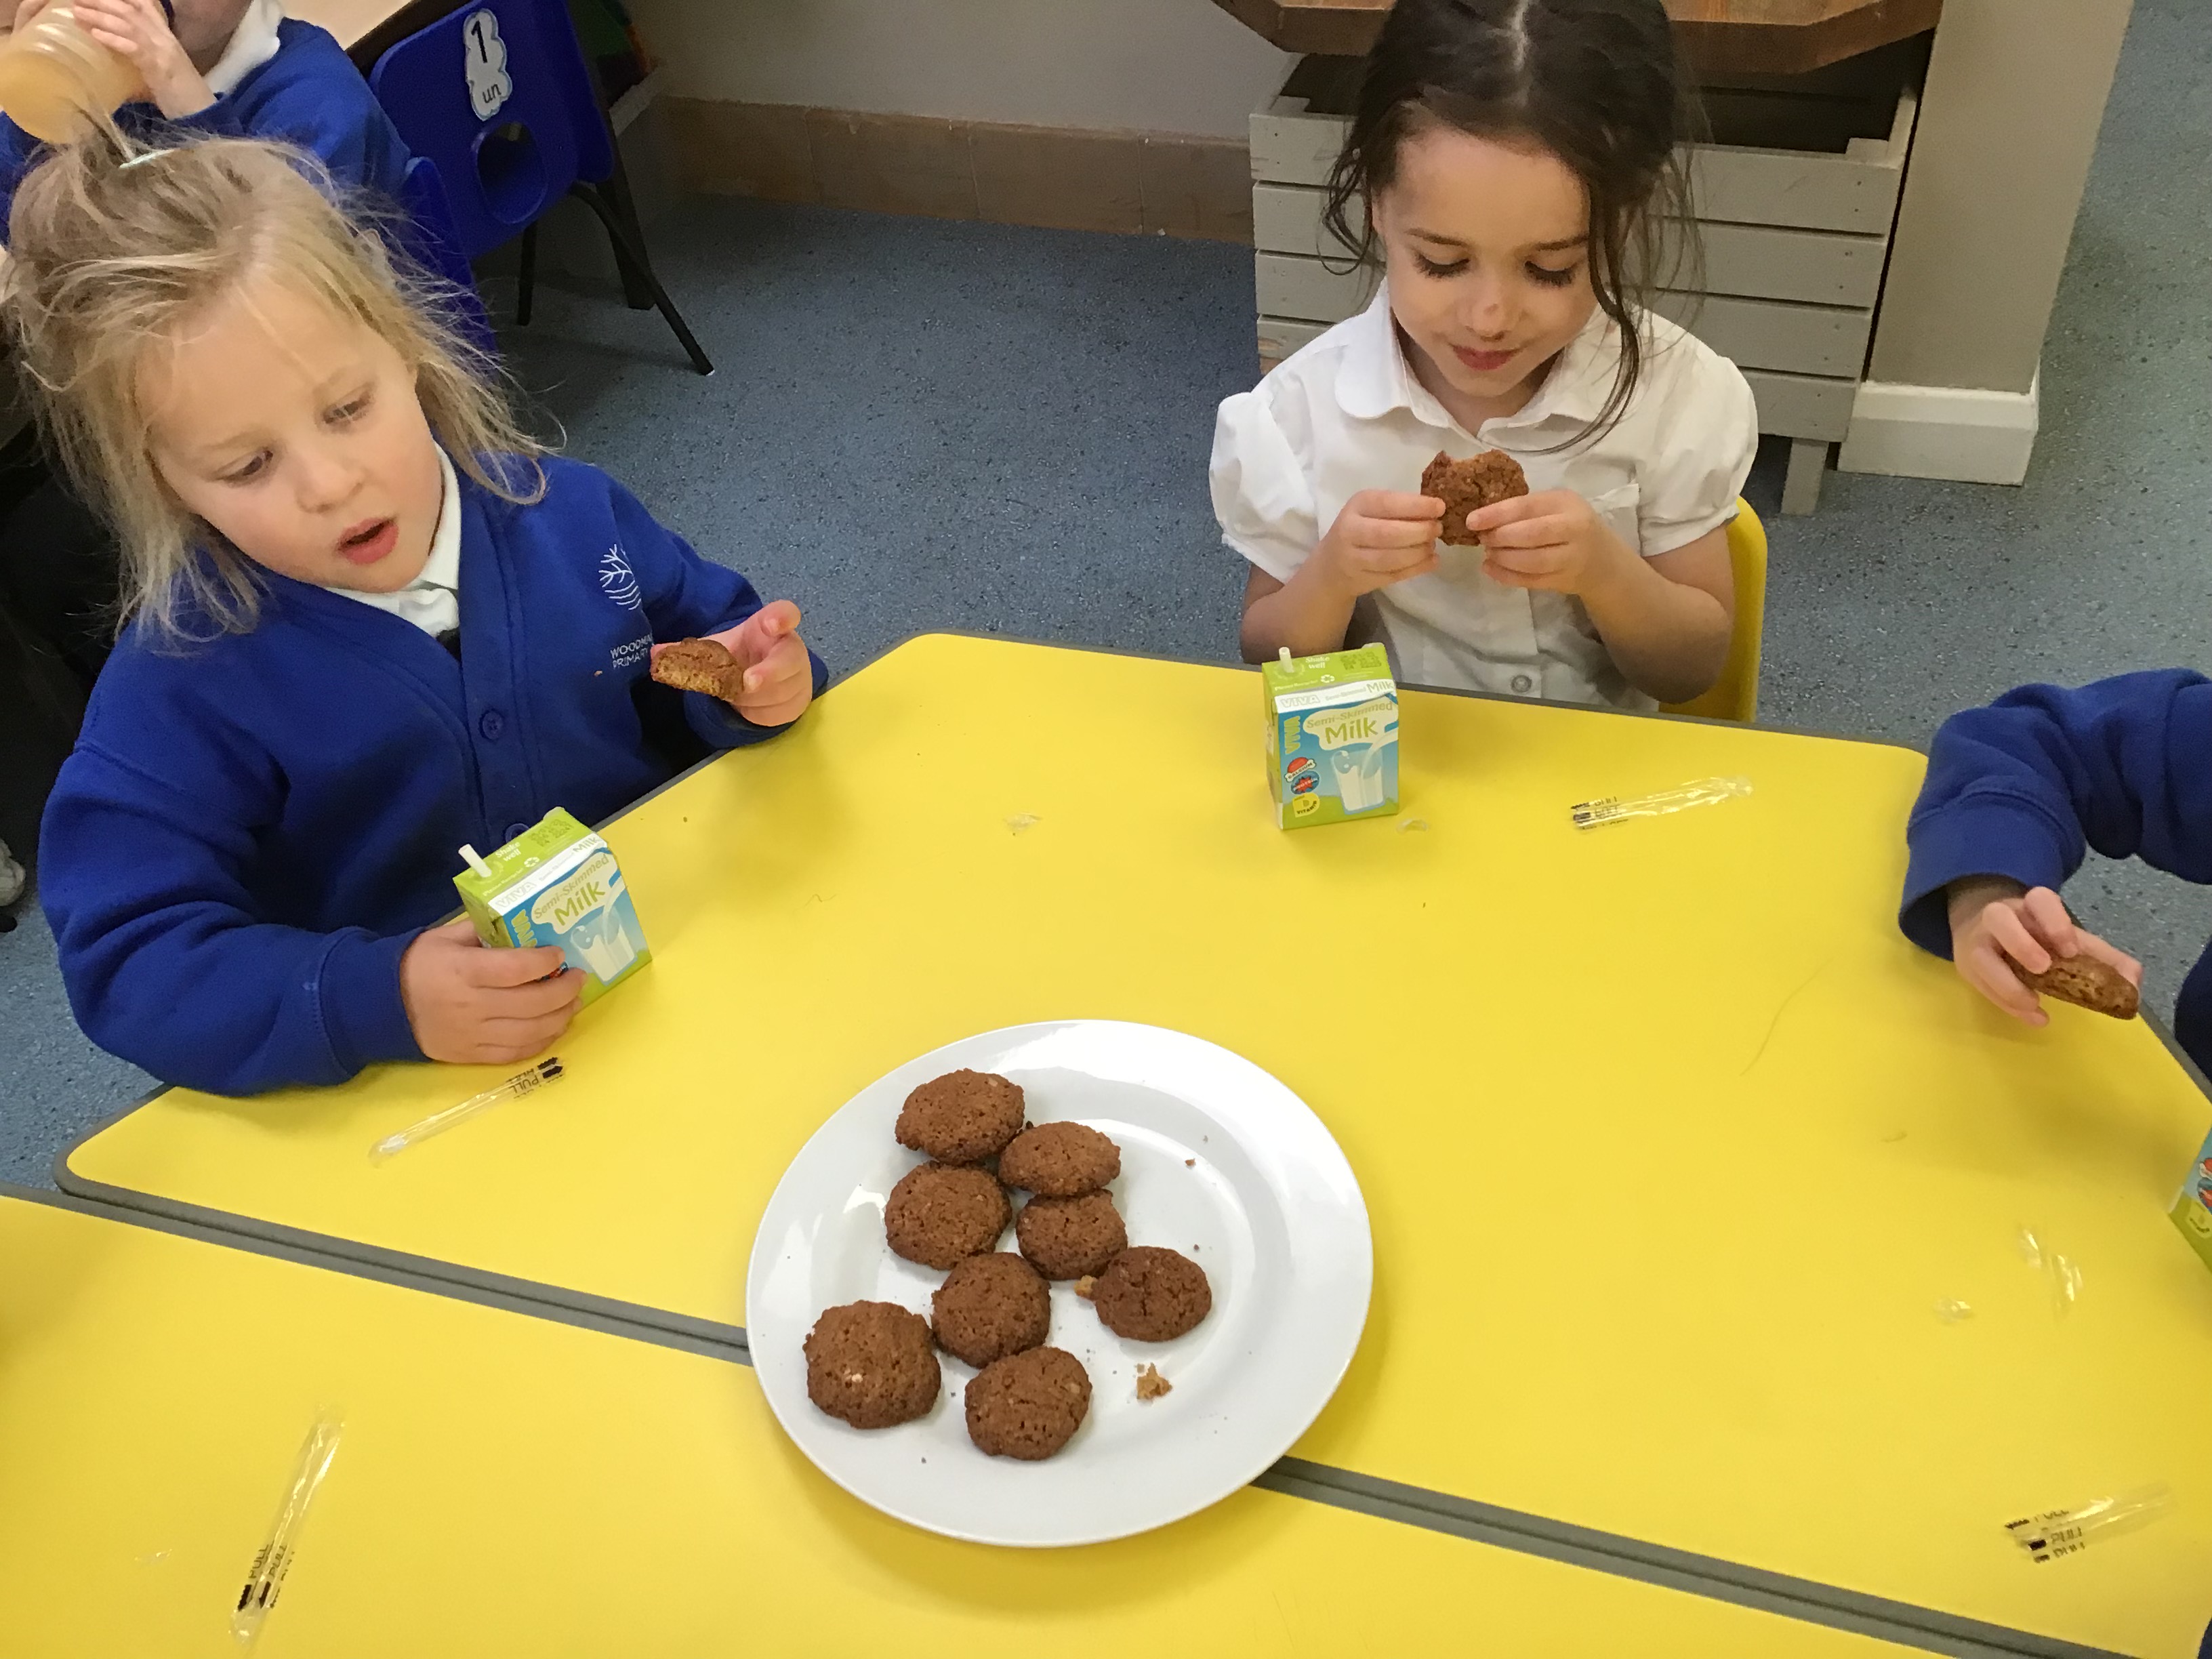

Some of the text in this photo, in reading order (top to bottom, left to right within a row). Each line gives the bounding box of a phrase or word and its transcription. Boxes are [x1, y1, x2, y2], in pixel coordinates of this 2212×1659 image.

[471, 20, 488, 63] 1
[482, 84, 502, 103] un
[1281, 694, 1321, 708] VIVA
[1366, 680, 1394, 693] Milk
[1307, 701, 1393, 729] Semi-Skimmed
[1325, 718, 1378, 744] Milk
[495, 841, 520, 857] Shake
[503, 849, 522, 862] well
[495, 880, 537, 908] VIVA
[573, 836, 600, 853] Milk
[534, 854, 609, 920] Semi-Skimmed
[554, 879, 606, 926] Milk
[508, 1075, 539, 1093] PULL
